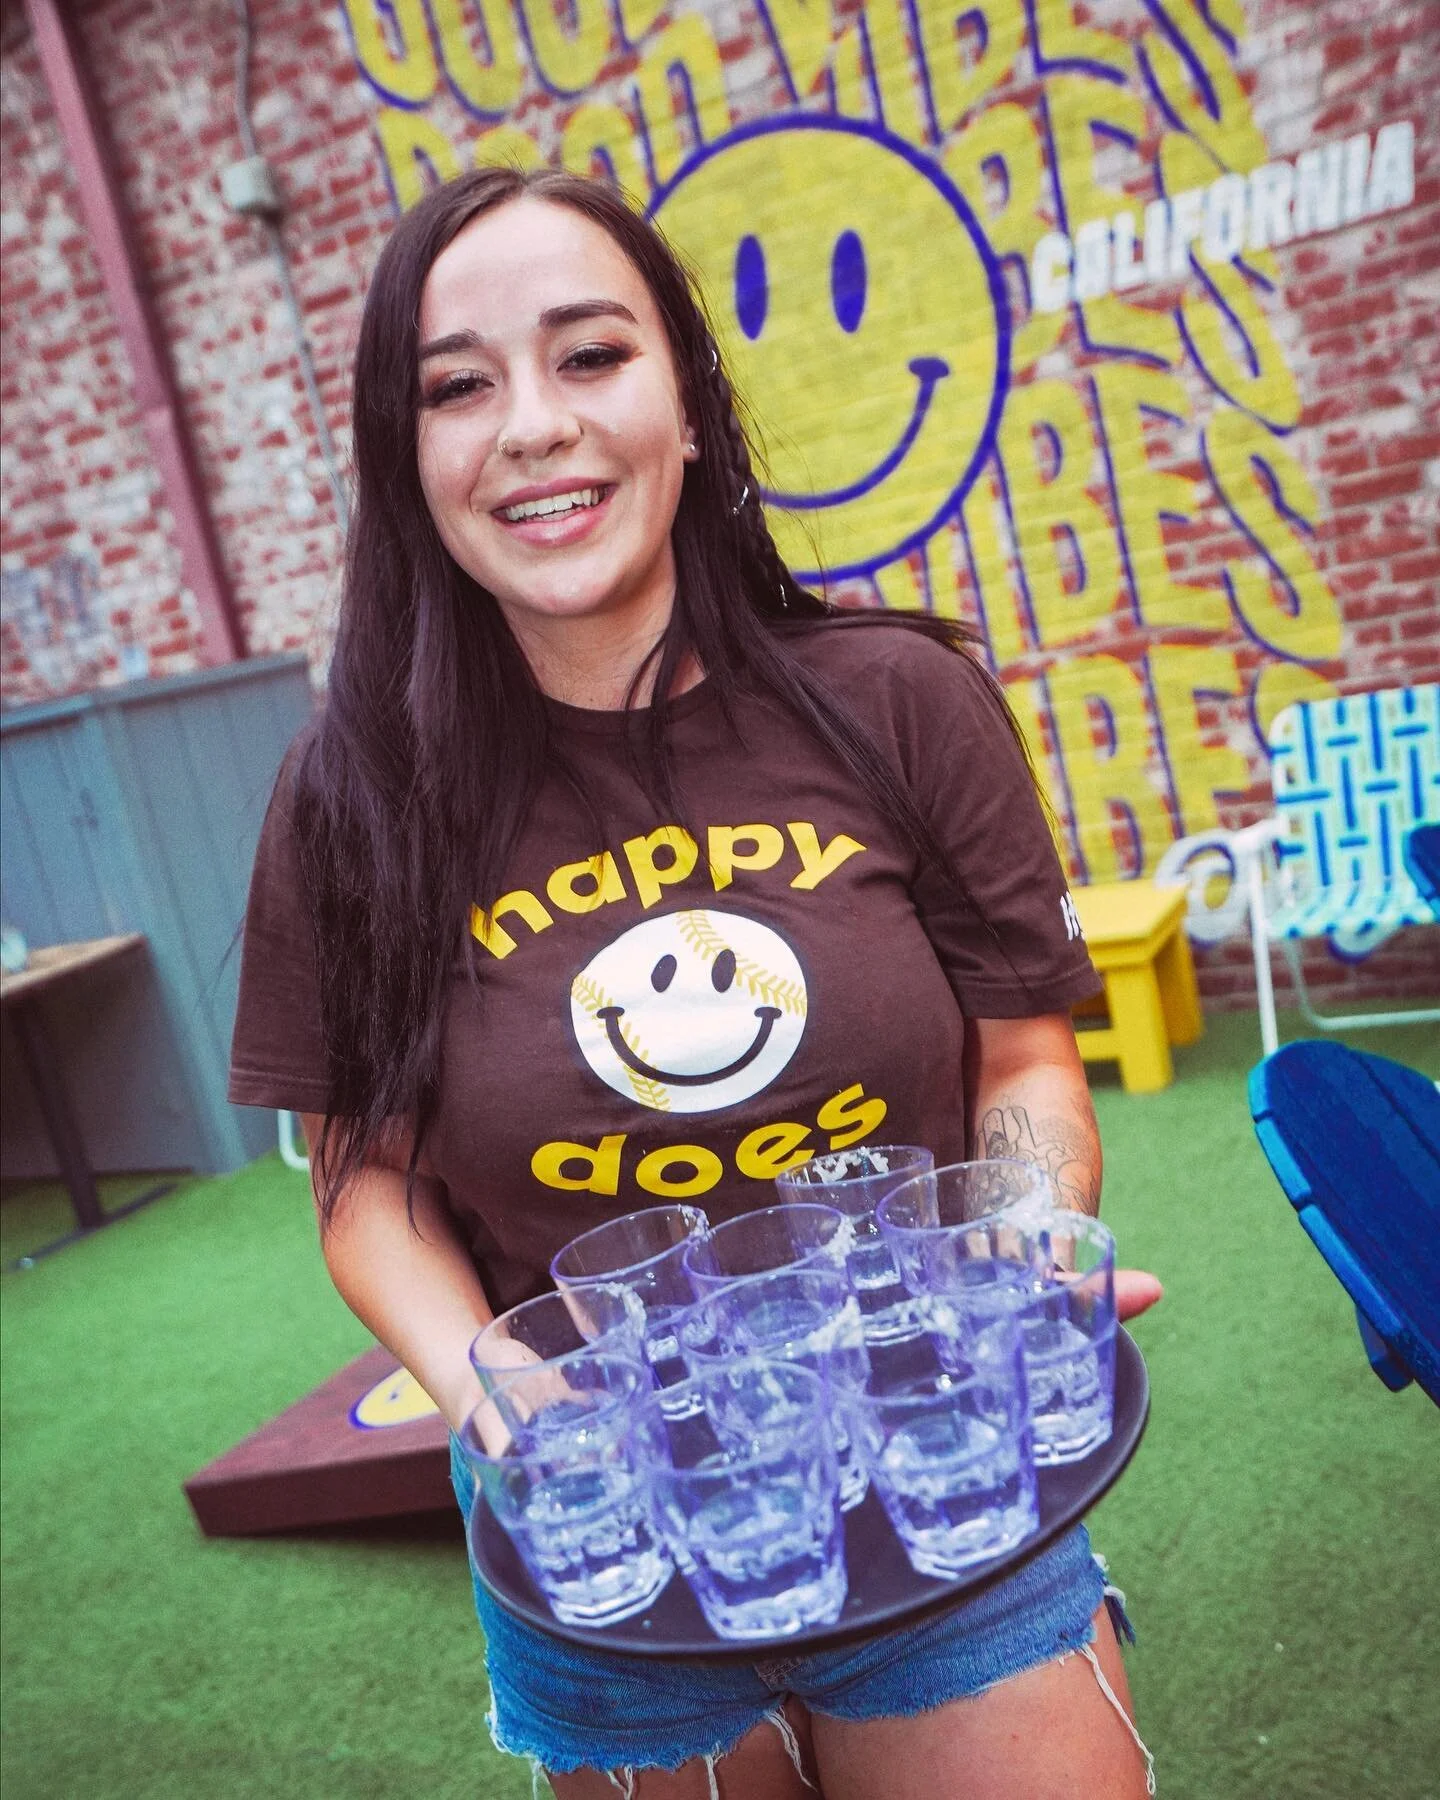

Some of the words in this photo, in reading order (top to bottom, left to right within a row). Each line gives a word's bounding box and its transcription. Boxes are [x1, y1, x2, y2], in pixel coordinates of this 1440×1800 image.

[1031, 120, 1415, 313] CALIFORNIA
[870, 365, 1344, 672] IBES
[470, 821, 868, 960] happy
[530, 1083, 888, 1198] does
